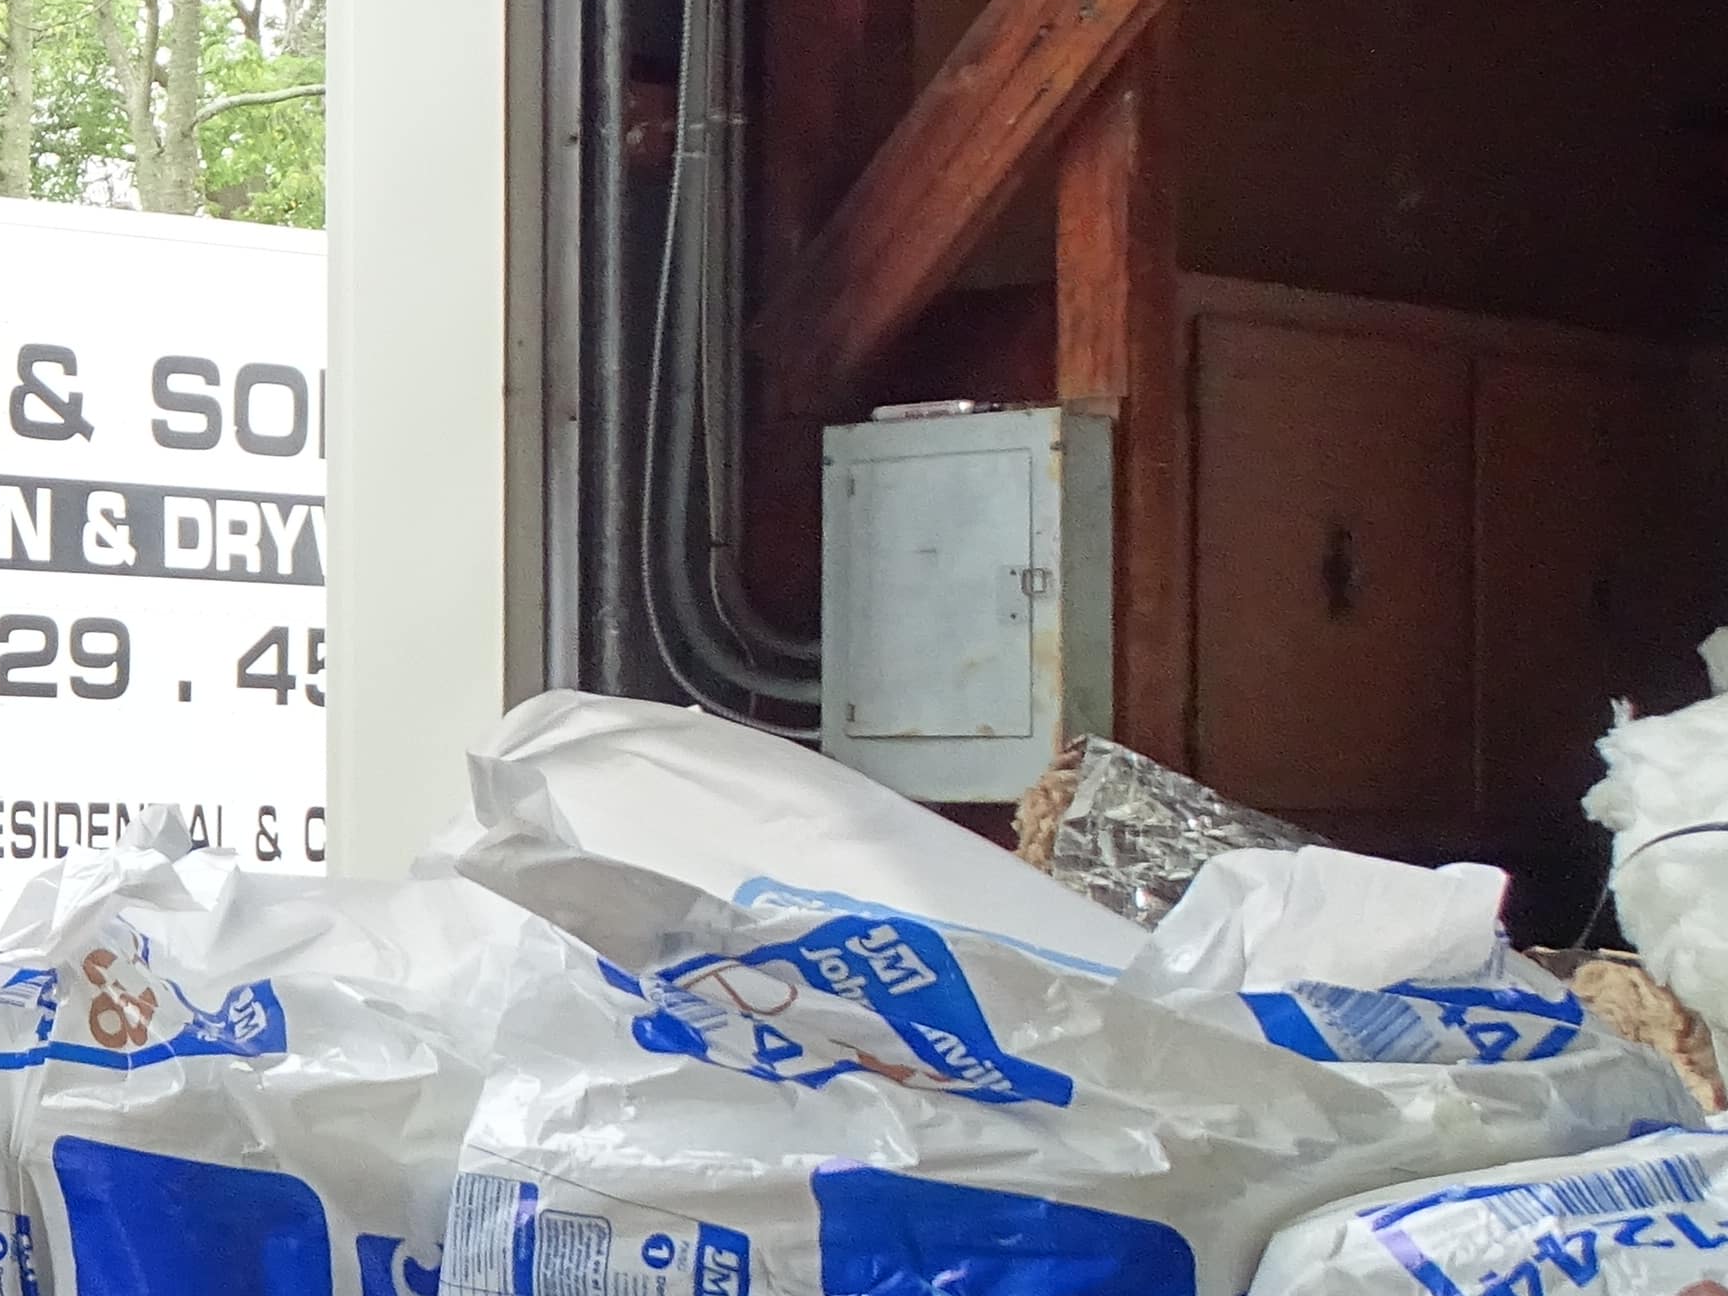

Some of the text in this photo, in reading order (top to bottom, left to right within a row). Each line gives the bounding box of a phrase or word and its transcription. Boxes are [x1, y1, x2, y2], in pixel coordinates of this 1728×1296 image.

[8, 342, 95, 444] &
[150, 355, 326, 459] SO
[81, 490, 137, 568] &
[163, 494, 326, 577] DRY
[255, 805, 281, 862] &
